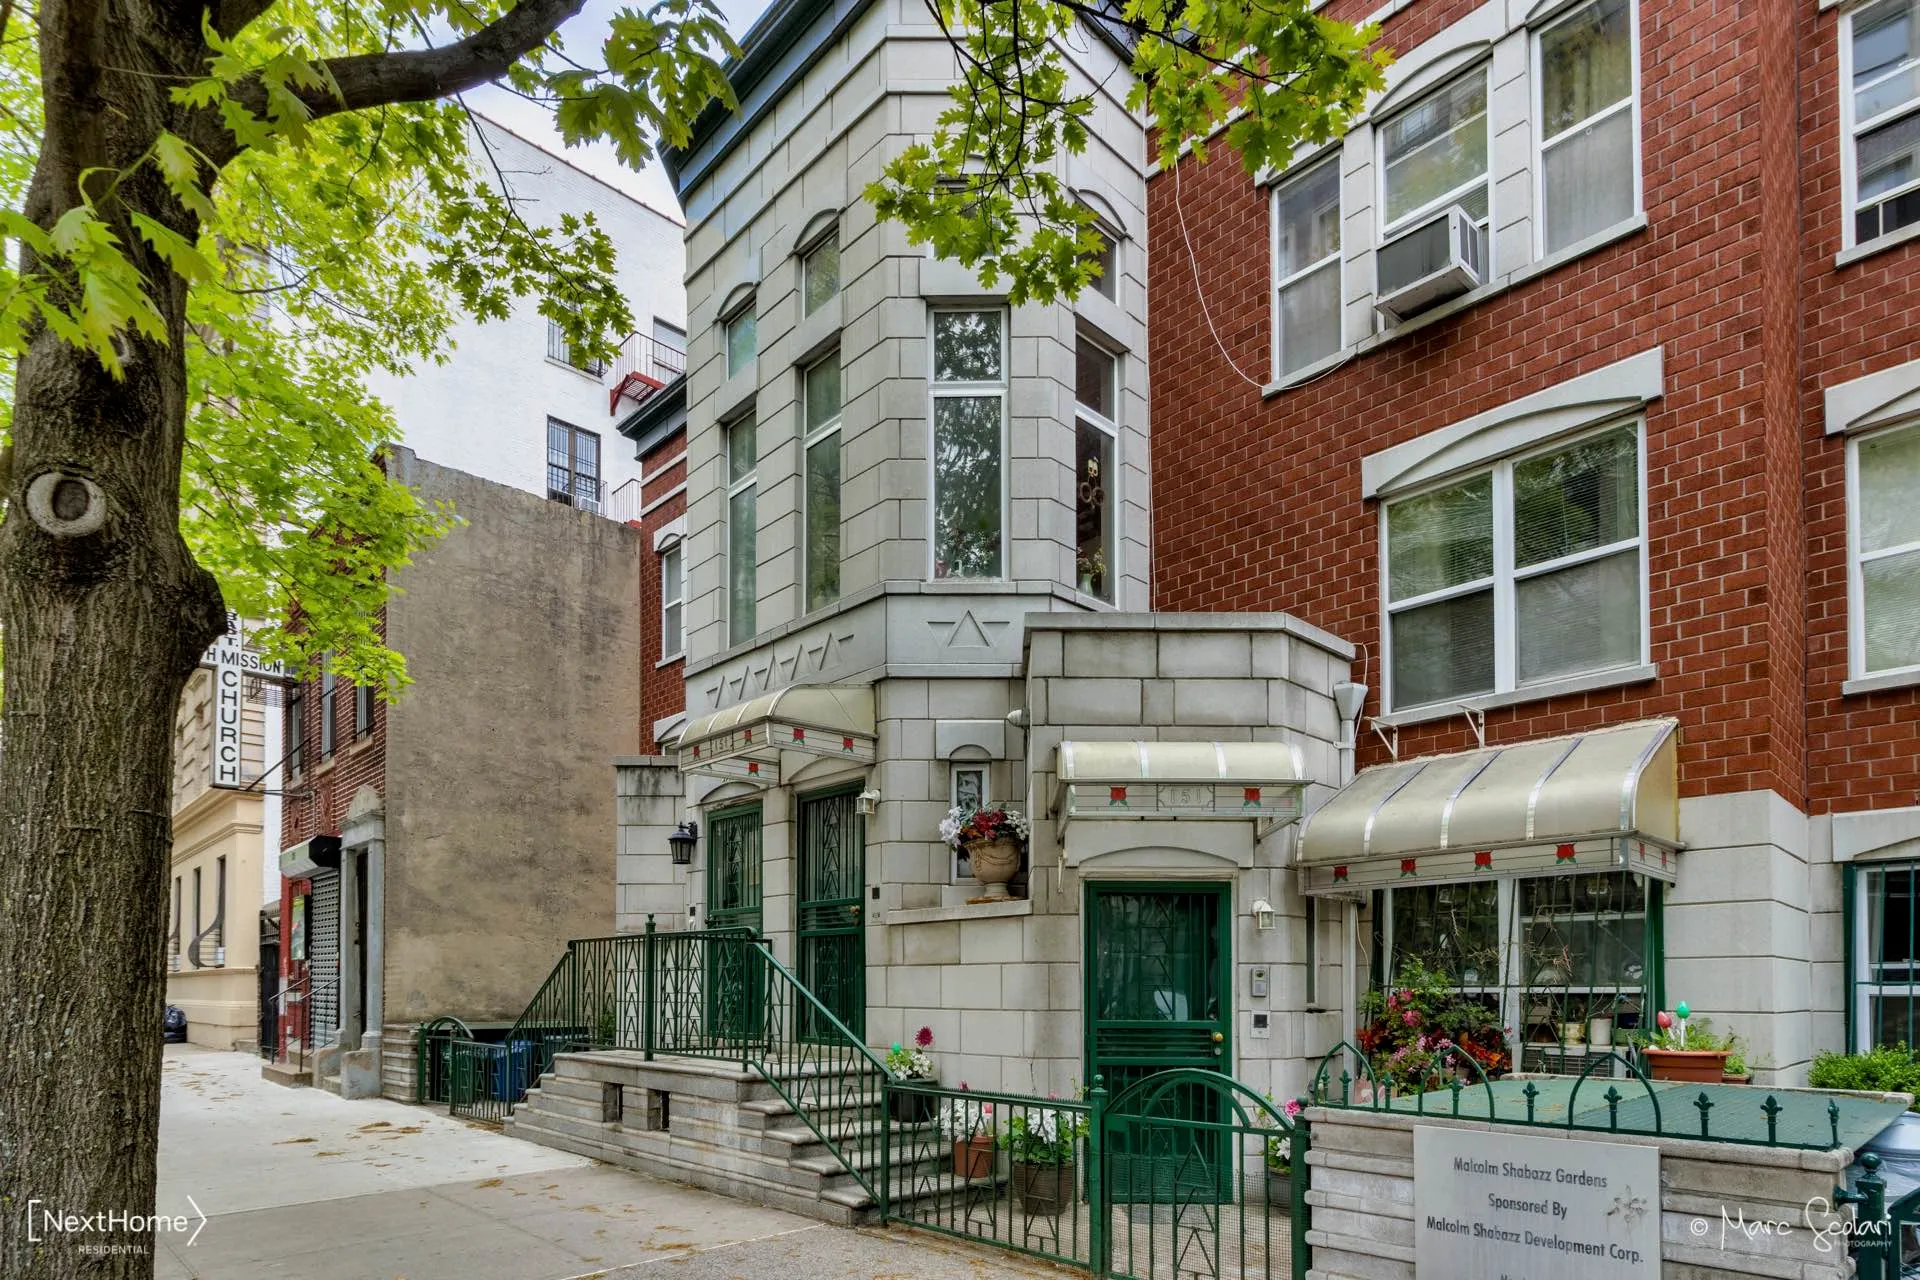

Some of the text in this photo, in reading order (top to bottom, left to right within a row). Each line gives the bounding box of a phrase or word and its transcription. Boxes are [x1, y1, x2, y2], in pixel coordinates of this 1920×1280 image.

[220, 670, 238, 783] CHURCH
[1453, 1157, 1608, 1188] Malcolm Shabazz Gardens
[1488, 1193, 1568, 1219] Sponsored By
[1427, 1215, 1644, 1265] Malcolm Shabazz Development Corp.
